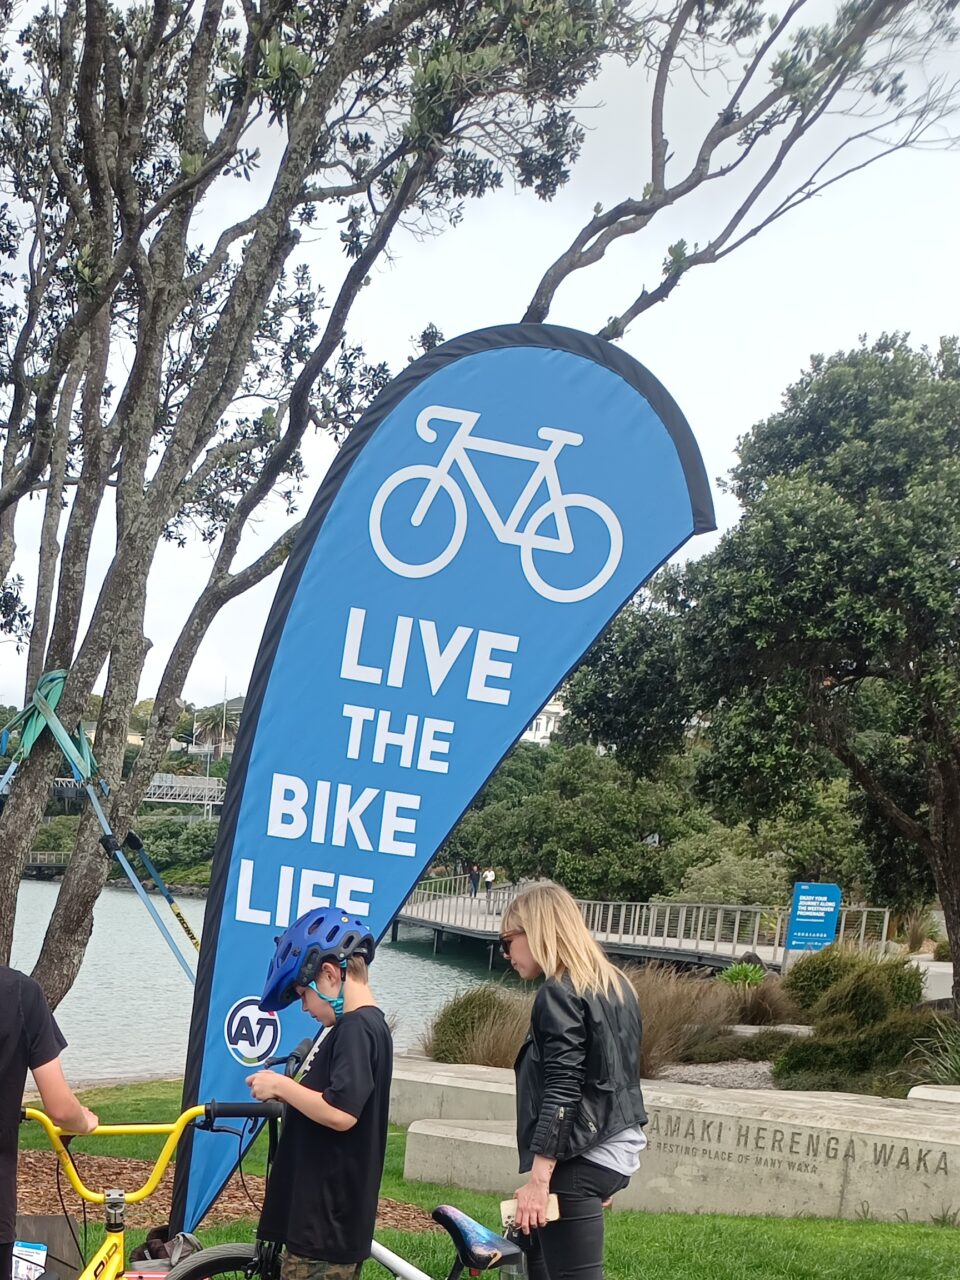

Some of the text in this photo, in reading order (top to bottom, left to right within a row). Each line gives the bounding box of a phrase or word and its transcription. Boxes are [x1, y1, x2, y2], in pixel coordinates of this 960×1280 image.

[340, 607, 520, 705] LIVE
[342, 704, 455, 774] THE
[266, 772, 421, 858] BIKE
[648, 1109, 949, 1176] ĀMAKI HERENGA WAKA
[656, 1141, 697, 1157] RESTING
[701, 1148, 733, 1162] PLACE
[737, 1153, 751, 1164] OF
[754, 1156, 783, 1169] MANY
